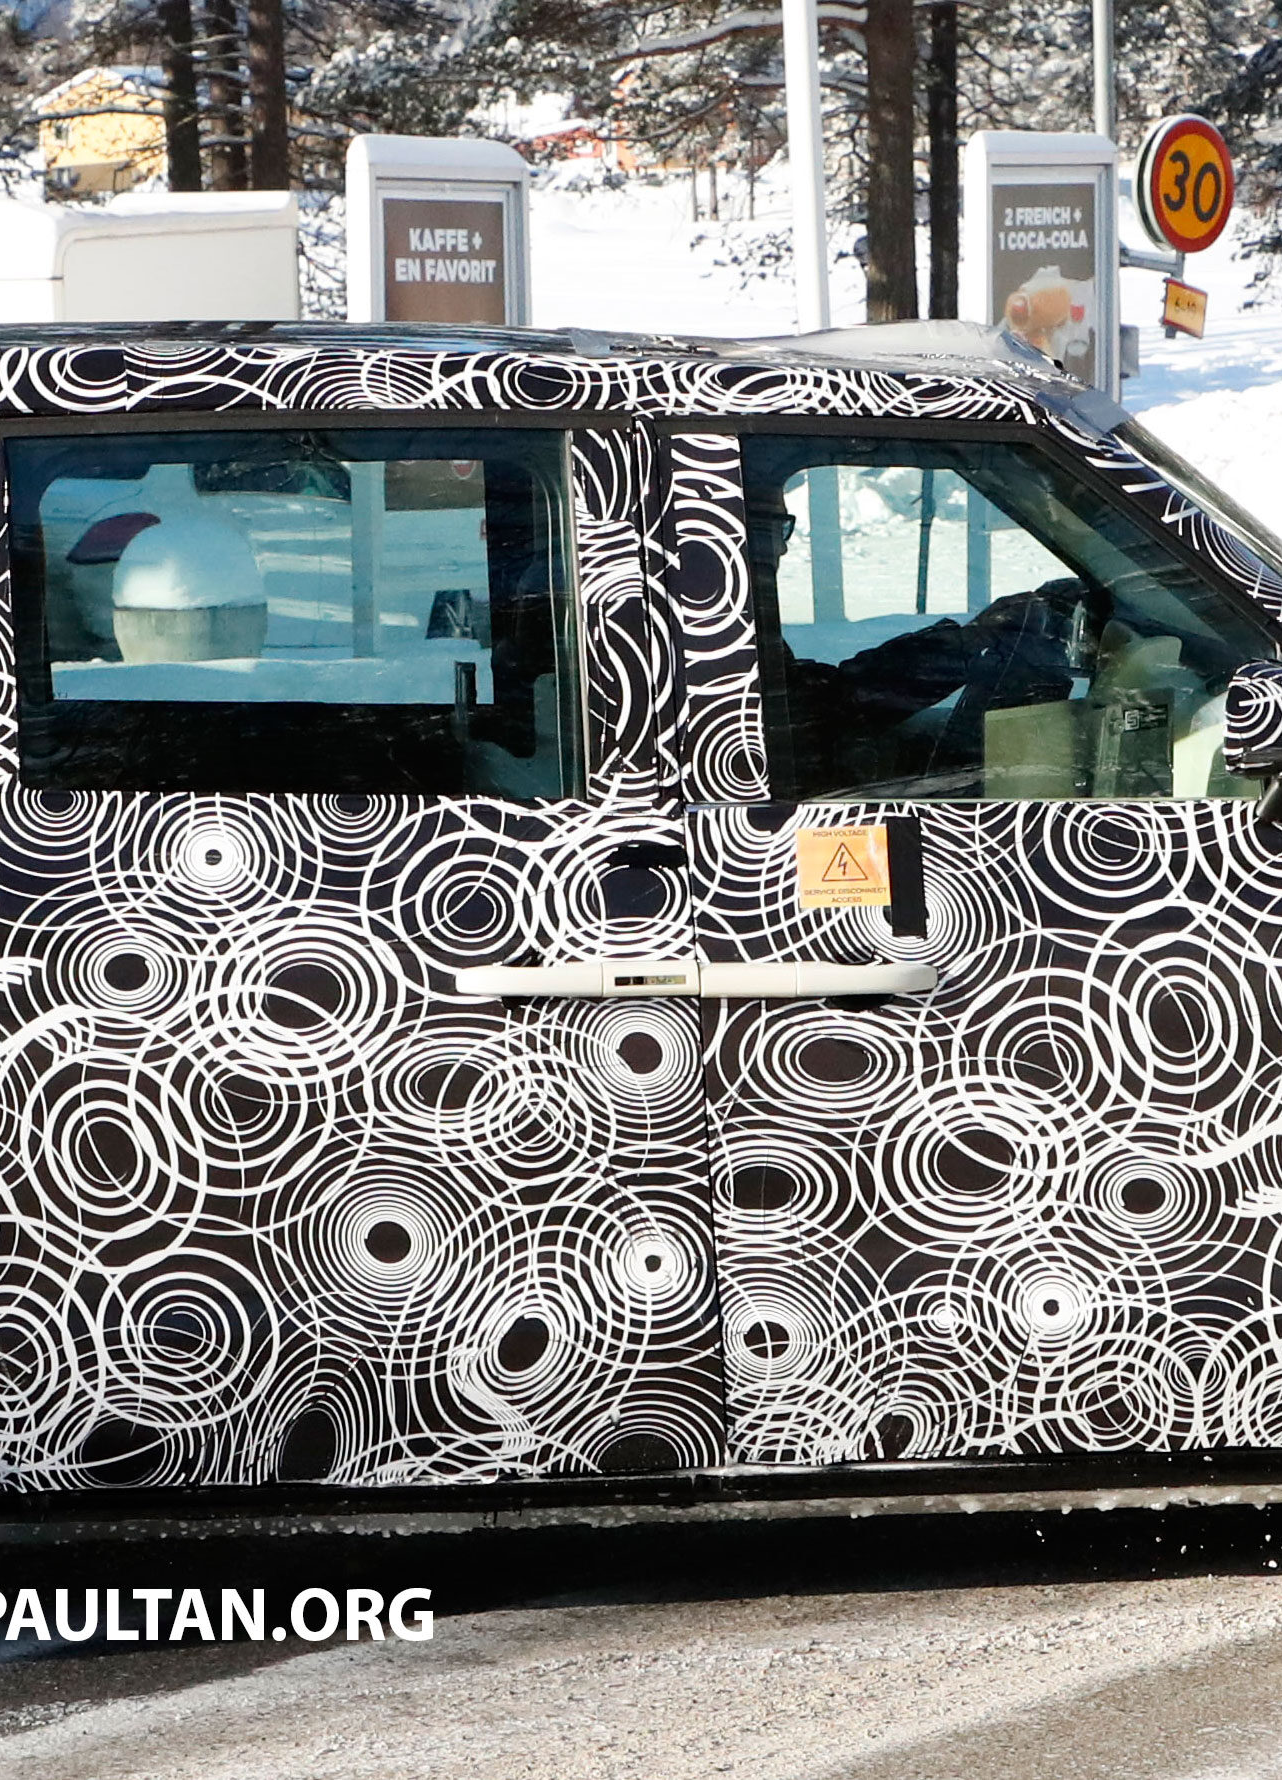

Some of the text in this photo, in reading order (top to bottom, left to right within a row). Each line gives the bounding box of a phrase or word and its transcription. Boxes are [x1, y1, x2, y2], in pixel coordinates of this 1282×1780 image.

[1163, 150, 1222, 223] 30
[1004, 208, 1013, 226] 2
[1016, 206, 1071, 226] FRENCH
[409, 228, 469, 252] KAFFE
[999, 230, 1088, 250] 1 COCA-COLA
[395, 258, 496, 282] EN FAVORIT
[833, 829, 868, 837] VOLTAGE
[804, 887, 887, 896] SERVICE DISCONNECT
